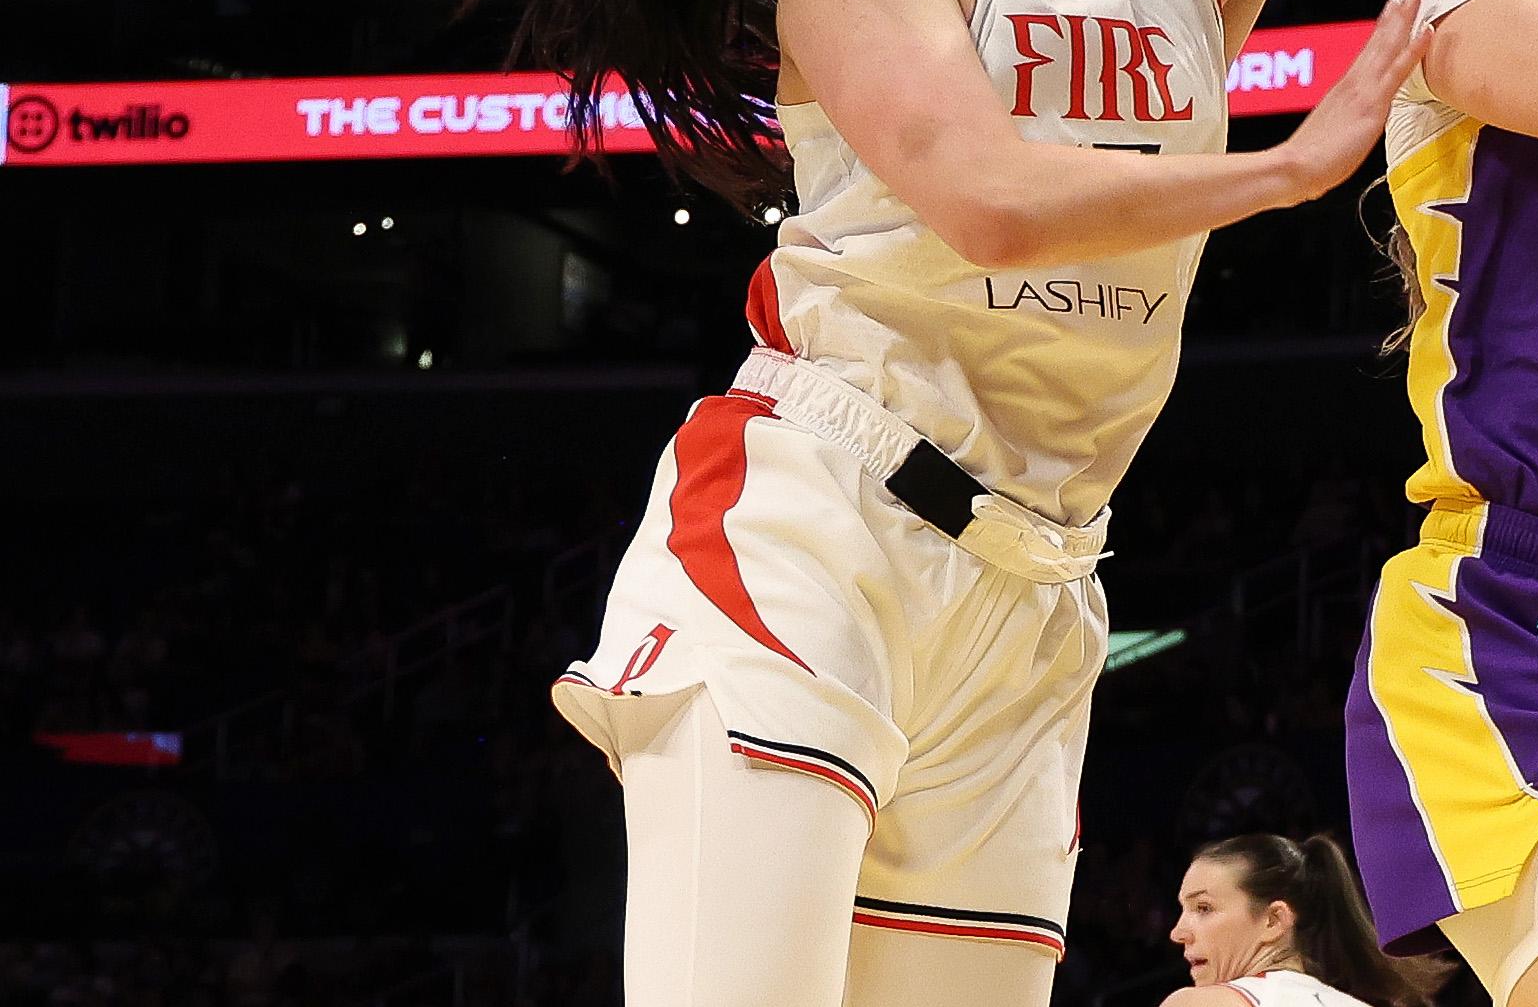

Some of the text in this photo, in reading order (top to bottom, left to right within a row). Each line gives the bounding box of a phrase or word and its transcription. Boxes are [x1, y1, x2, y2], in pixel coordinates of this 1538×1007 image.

[1003, 14, 1194, 121] FIRE
[69, 107, 190, 141] twilio
[296, 96, 402, 137] THE
[984, 277, 1168, 324] LASHIFY
